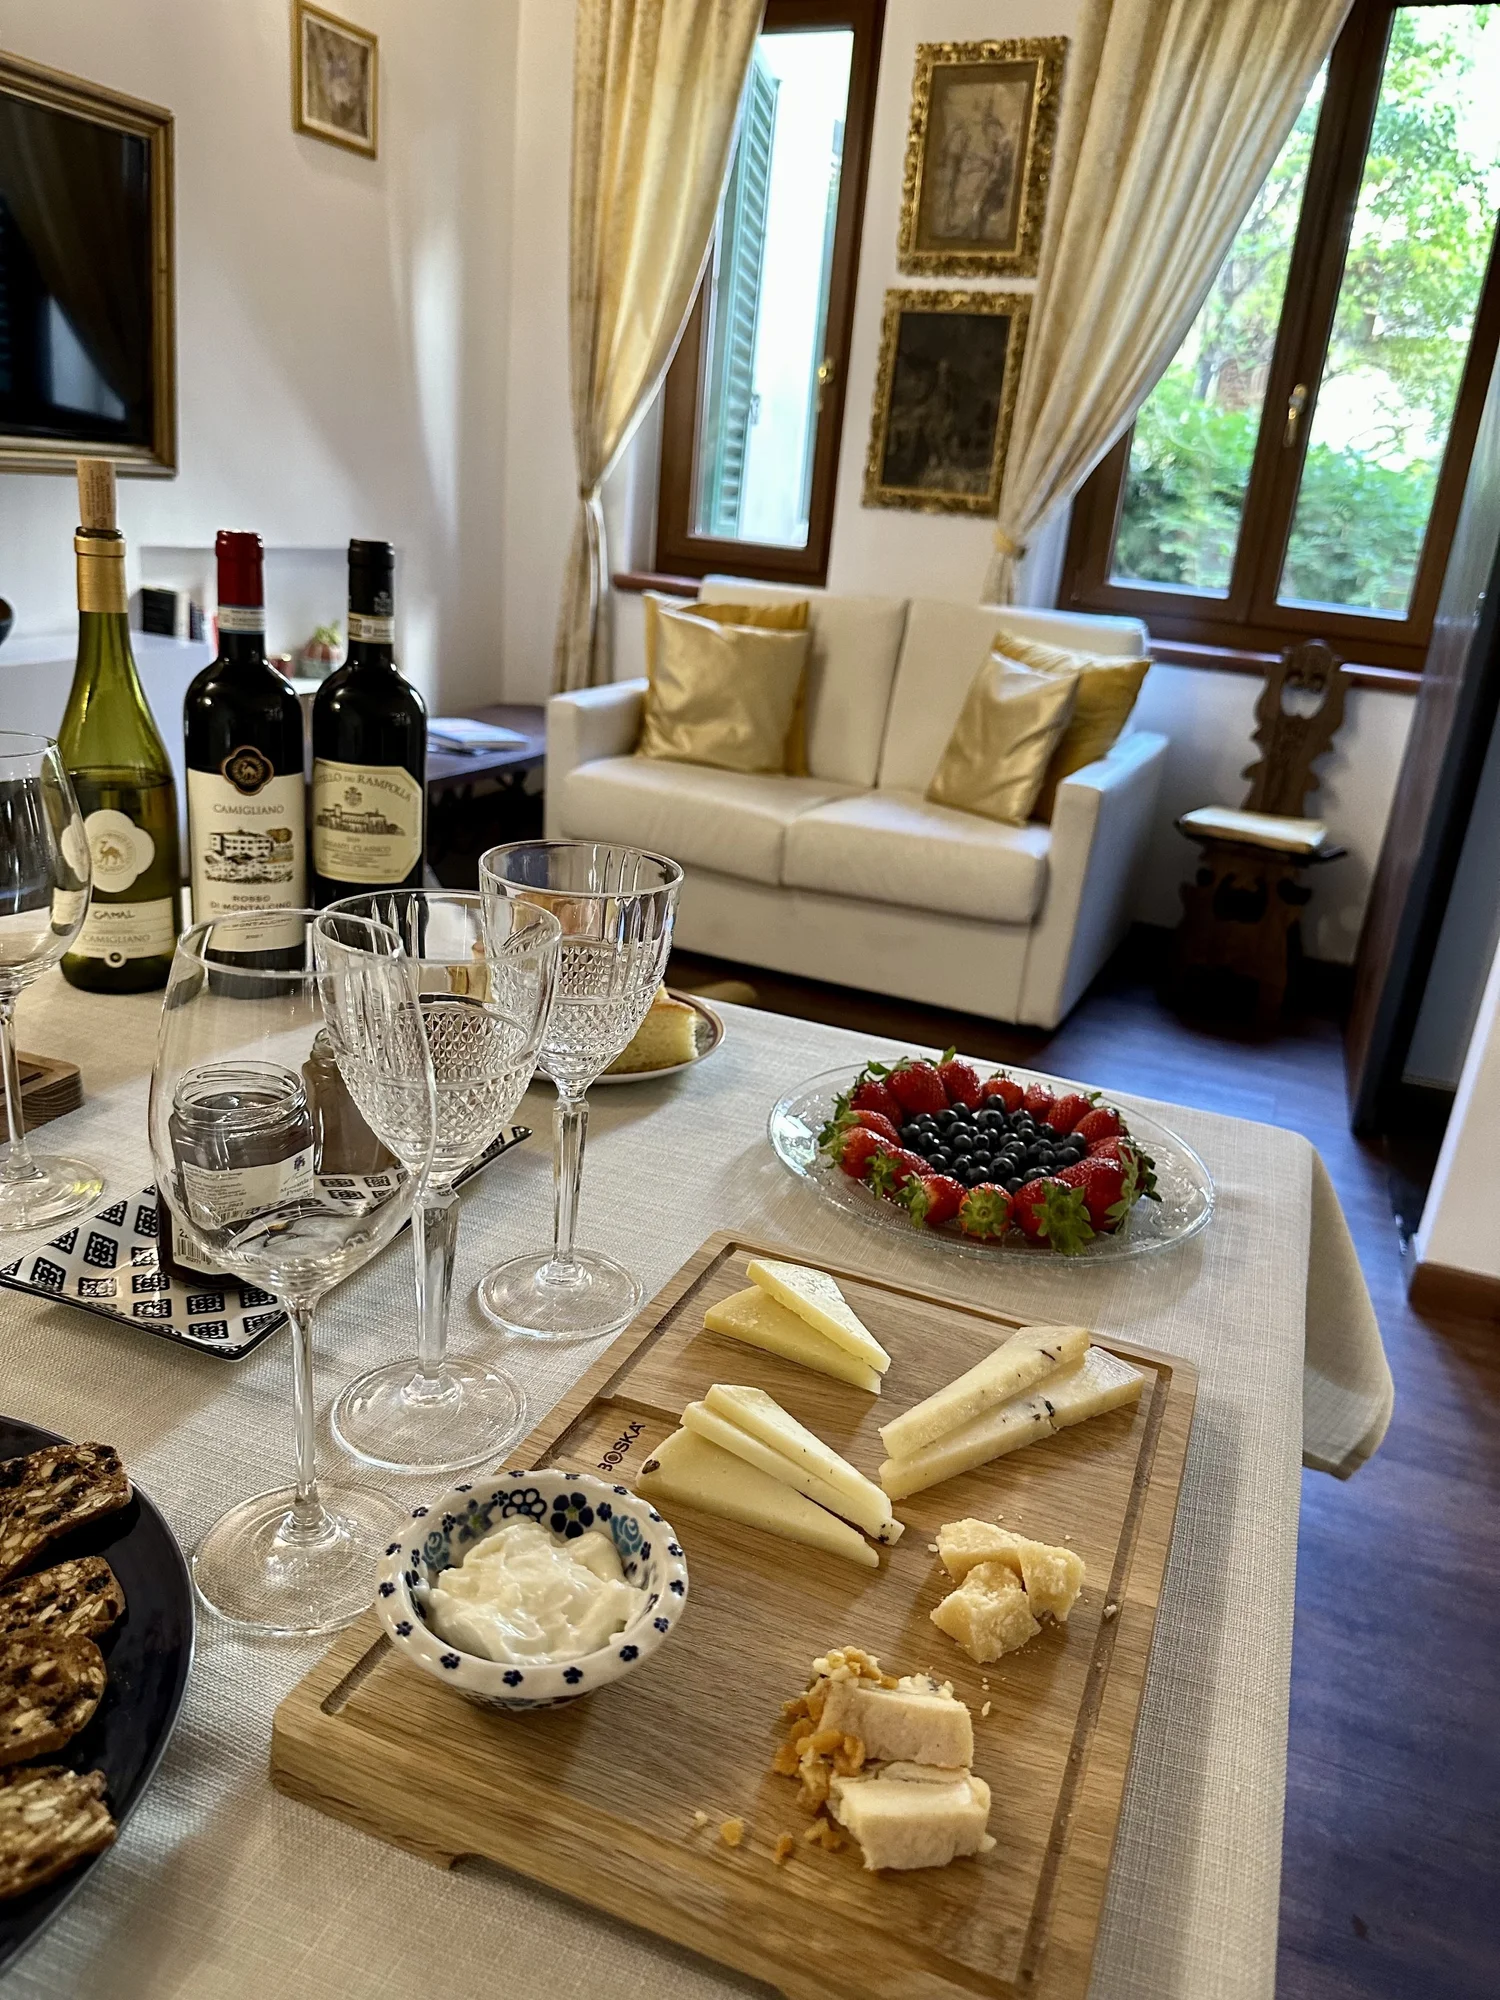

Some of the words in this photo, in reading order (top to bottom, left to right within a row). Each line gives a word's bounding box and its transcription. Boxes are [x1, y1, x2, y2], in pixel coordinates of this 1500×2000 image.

[357, 774, 411, 802] RAMPOLLA
[213, 803, 285, 816] CAMIGLIANO
[232, 894, 271, 902] ROSSO
[210, 901, 220, 909] DI
[222, 901, 291, 911] MONTALCINO
[597, 1424, 646, 1472] BOSKA
